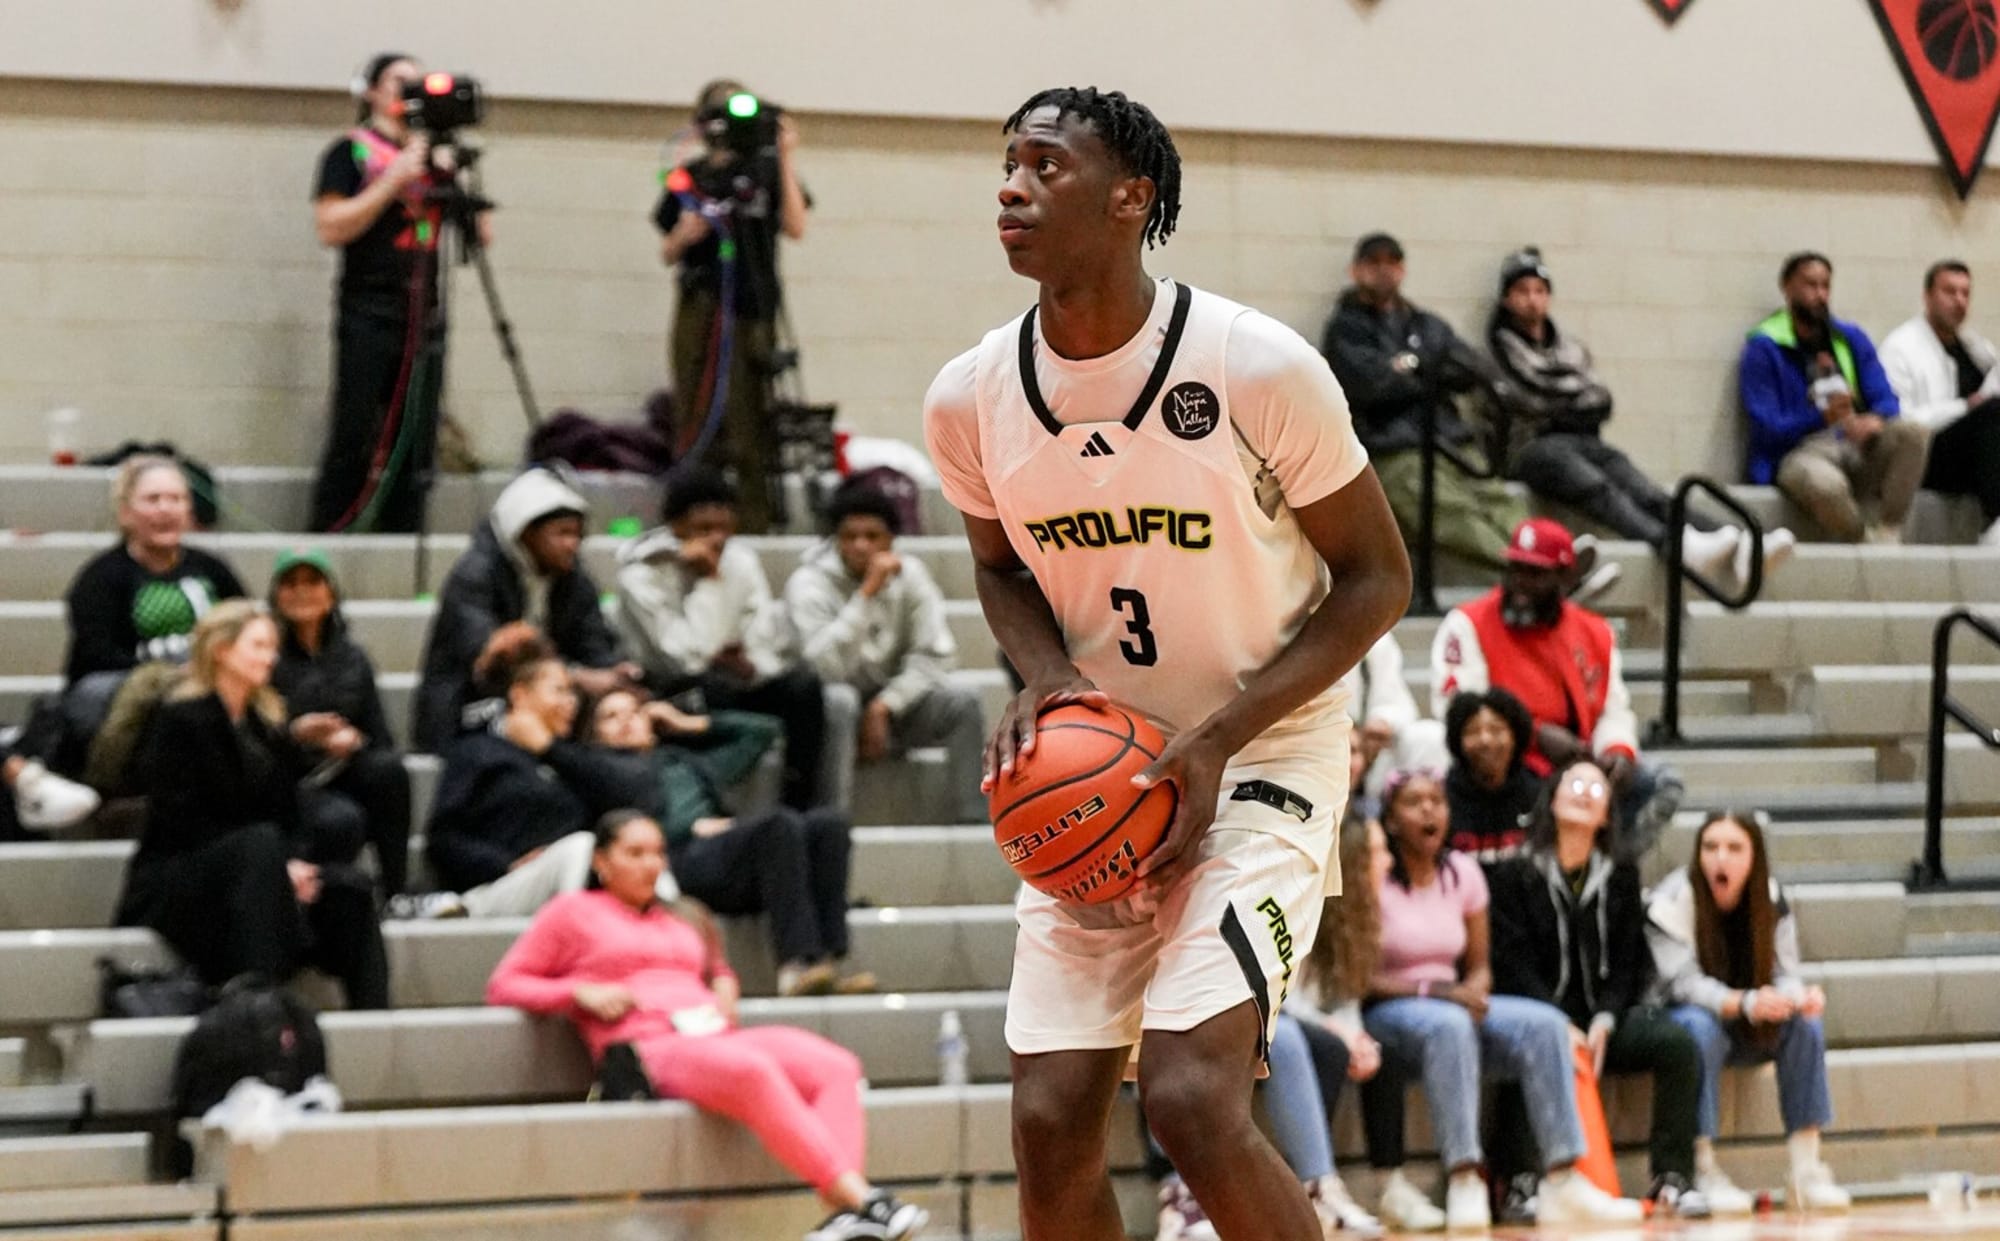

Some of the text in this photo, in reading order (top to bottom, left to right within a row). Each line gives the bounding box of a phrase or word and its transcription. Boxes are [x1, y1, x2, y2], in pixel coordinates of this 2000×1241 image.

[1172, 390, 1208, 411] Napa
[1173, 409, 1212, 432] Valley
[1024, 507, 1212, 553] PROLIFIC
[1110, 587, 1158, 667] 3
[1023, 793, 1107, 851] ELITE
